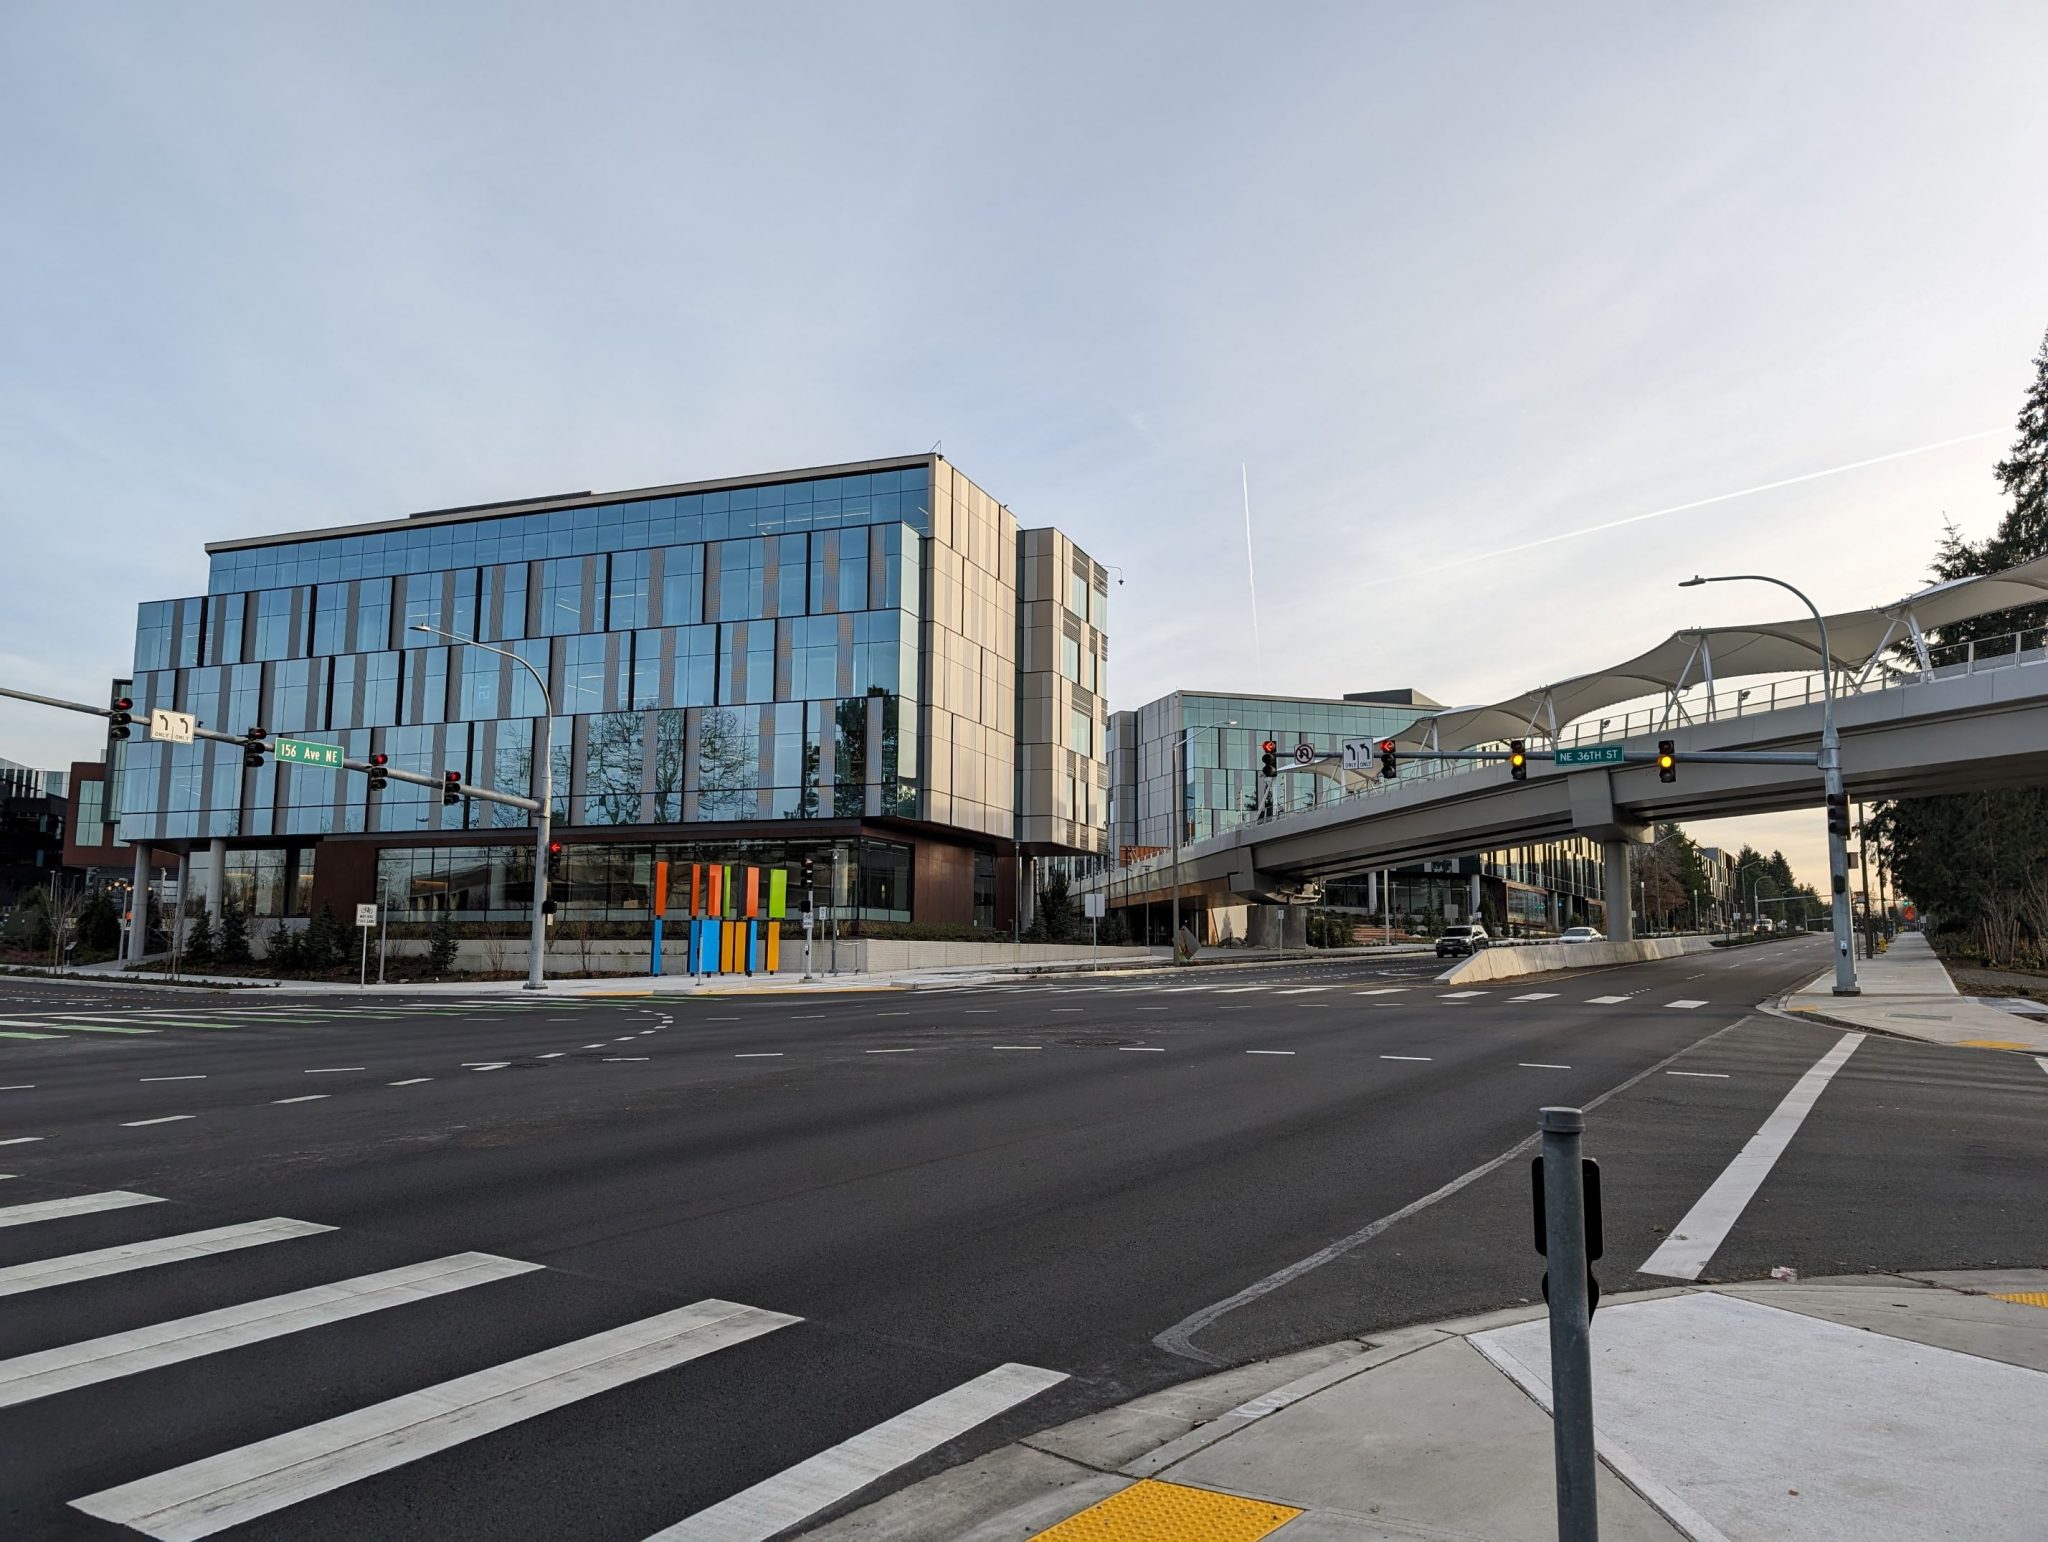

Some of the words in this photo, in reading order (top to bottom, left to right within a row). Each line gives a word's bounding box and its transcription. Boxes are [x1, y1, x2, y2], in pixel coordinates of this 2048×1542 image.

[154, 731, 169, 739] ONLY
[281, 743, 297, 758] 156
[303, 747, 321, 761] Ave
[325, 749, 338, 764] NE
[1560, 752, 1573, 762] NE
[1577, 750, 1602, 761] 36TH
[1606, 749, 1618, 759] ST
